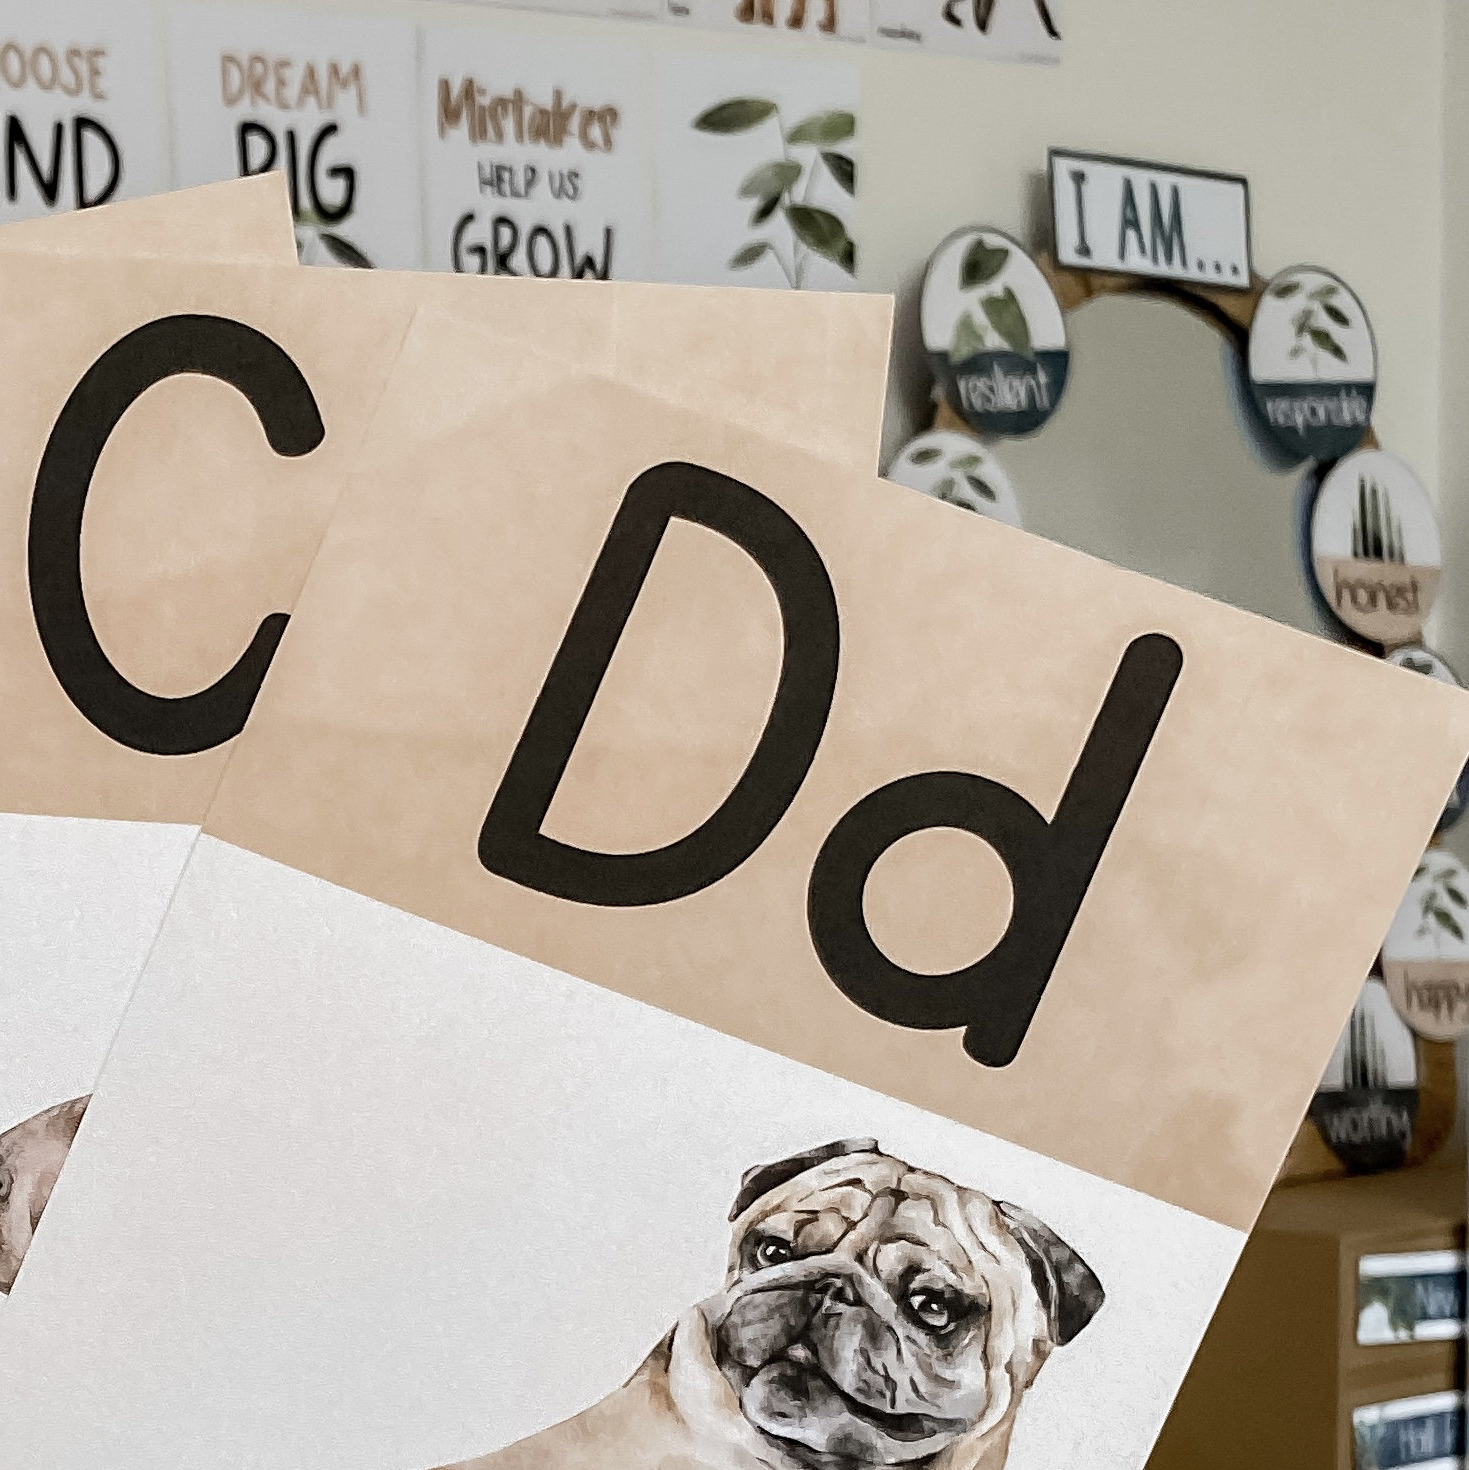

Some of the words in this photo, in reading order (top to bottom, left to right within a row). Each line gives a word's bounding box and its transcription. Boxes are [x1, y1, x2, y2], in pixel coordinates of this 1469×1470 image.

[221, 53, 367, 116] DREAM
[437, 77, 620, 152] Mistakes
[477, 160, 539, 200] HELP
[548, 167, 581, 201] US
[1070, 170, 1091, 258] I
[451, 208, 614, 281] GROW
[27, 315, 326, 756] C
[476, 460, 1183, 1068] Dd
